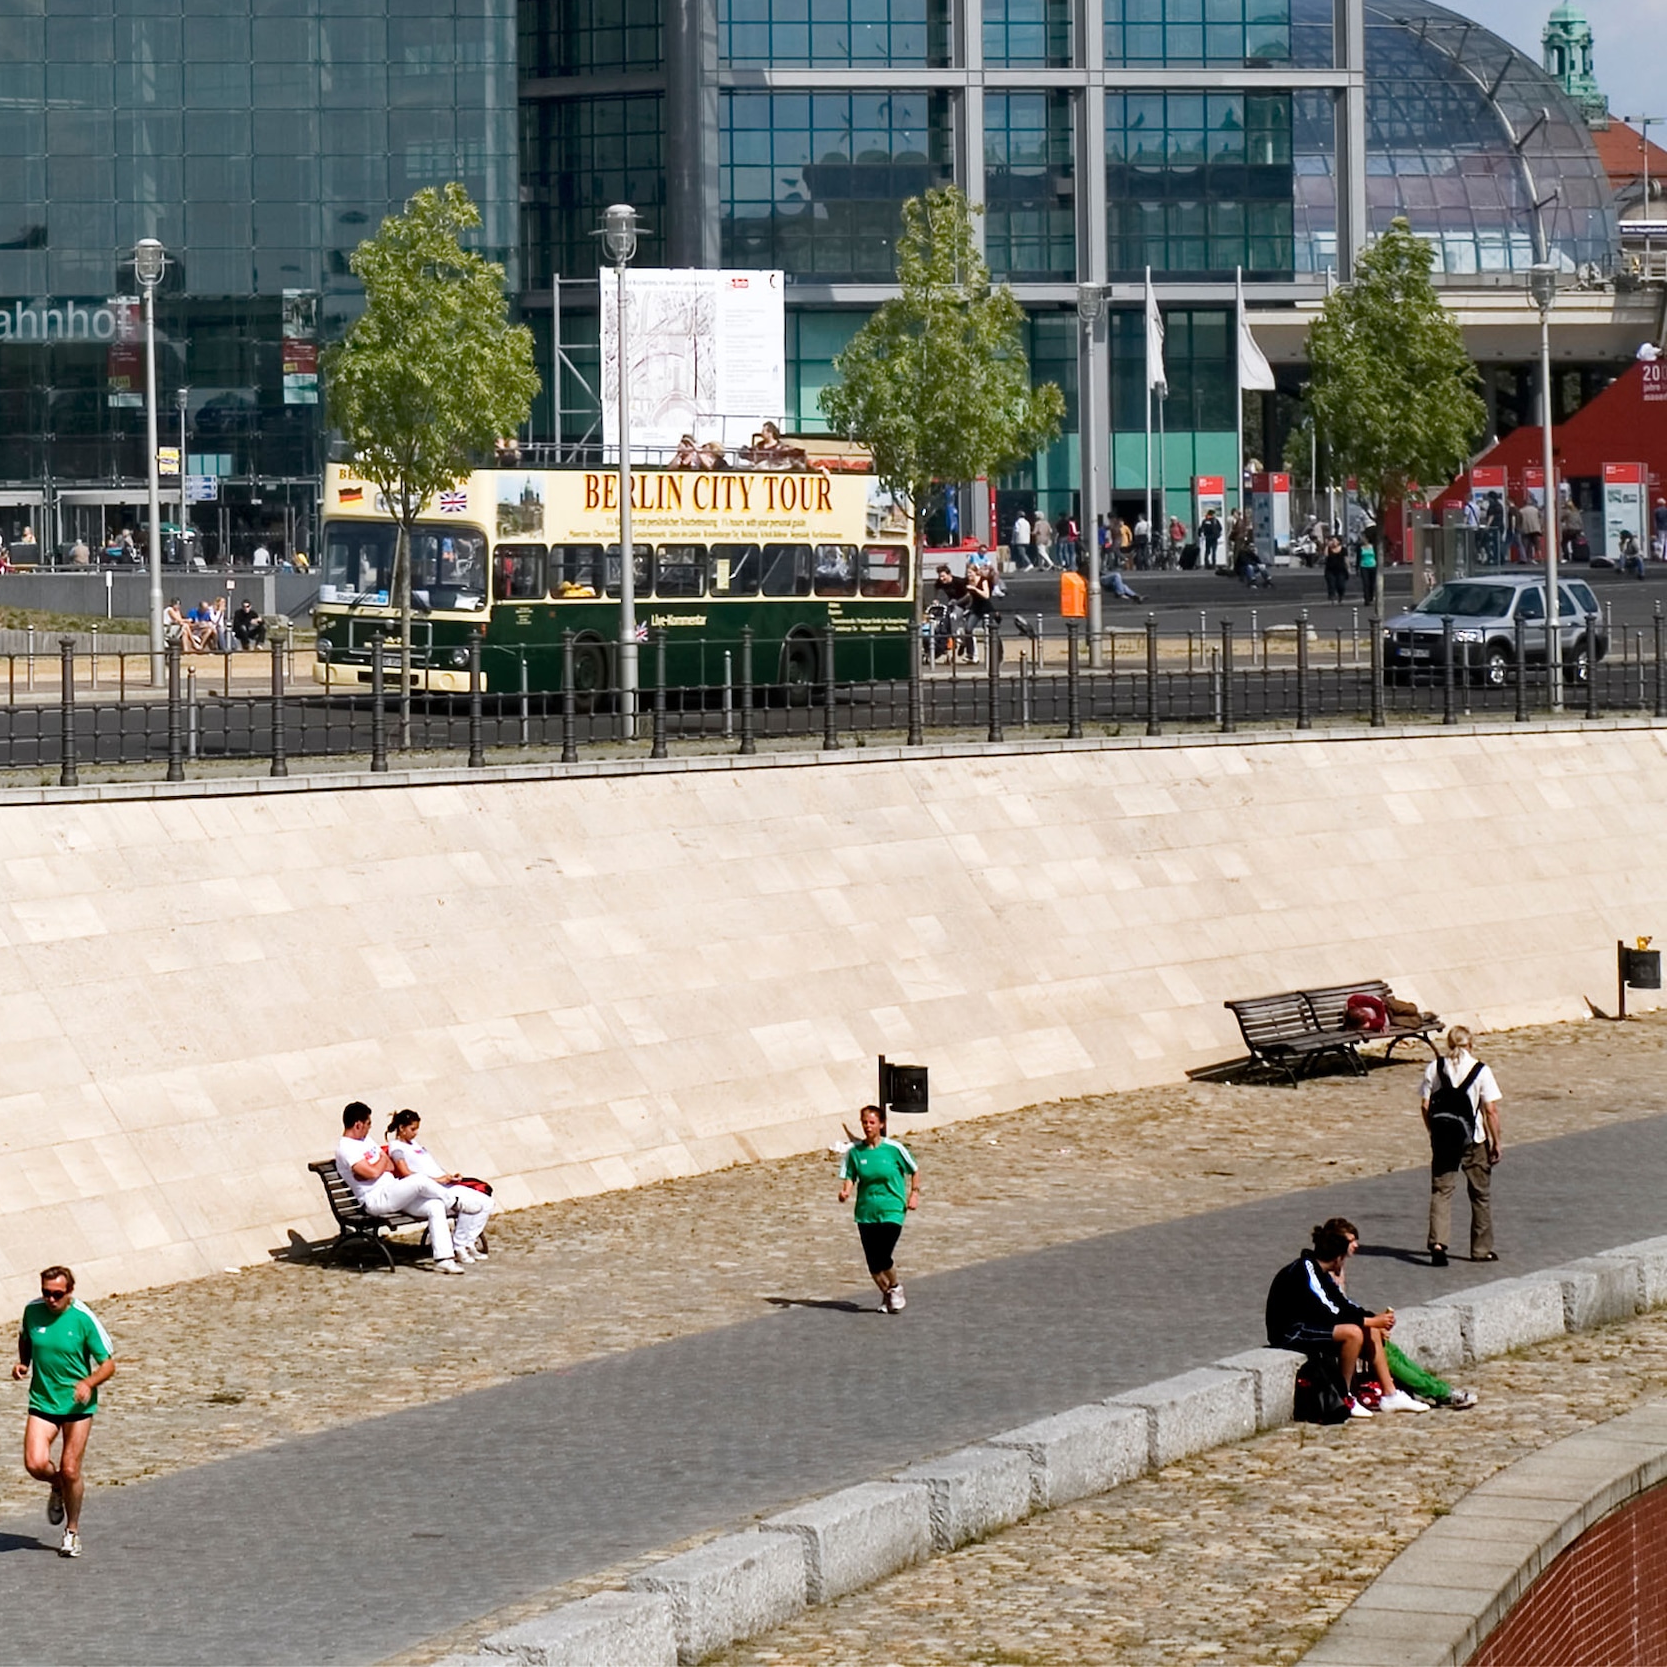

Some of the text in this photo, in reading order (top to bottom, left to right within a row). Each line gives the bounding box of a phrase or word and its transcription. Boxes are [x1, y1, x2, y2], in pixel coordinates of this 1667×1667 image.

[584, 474, 833, 513] BERLIN CITY TOUR
